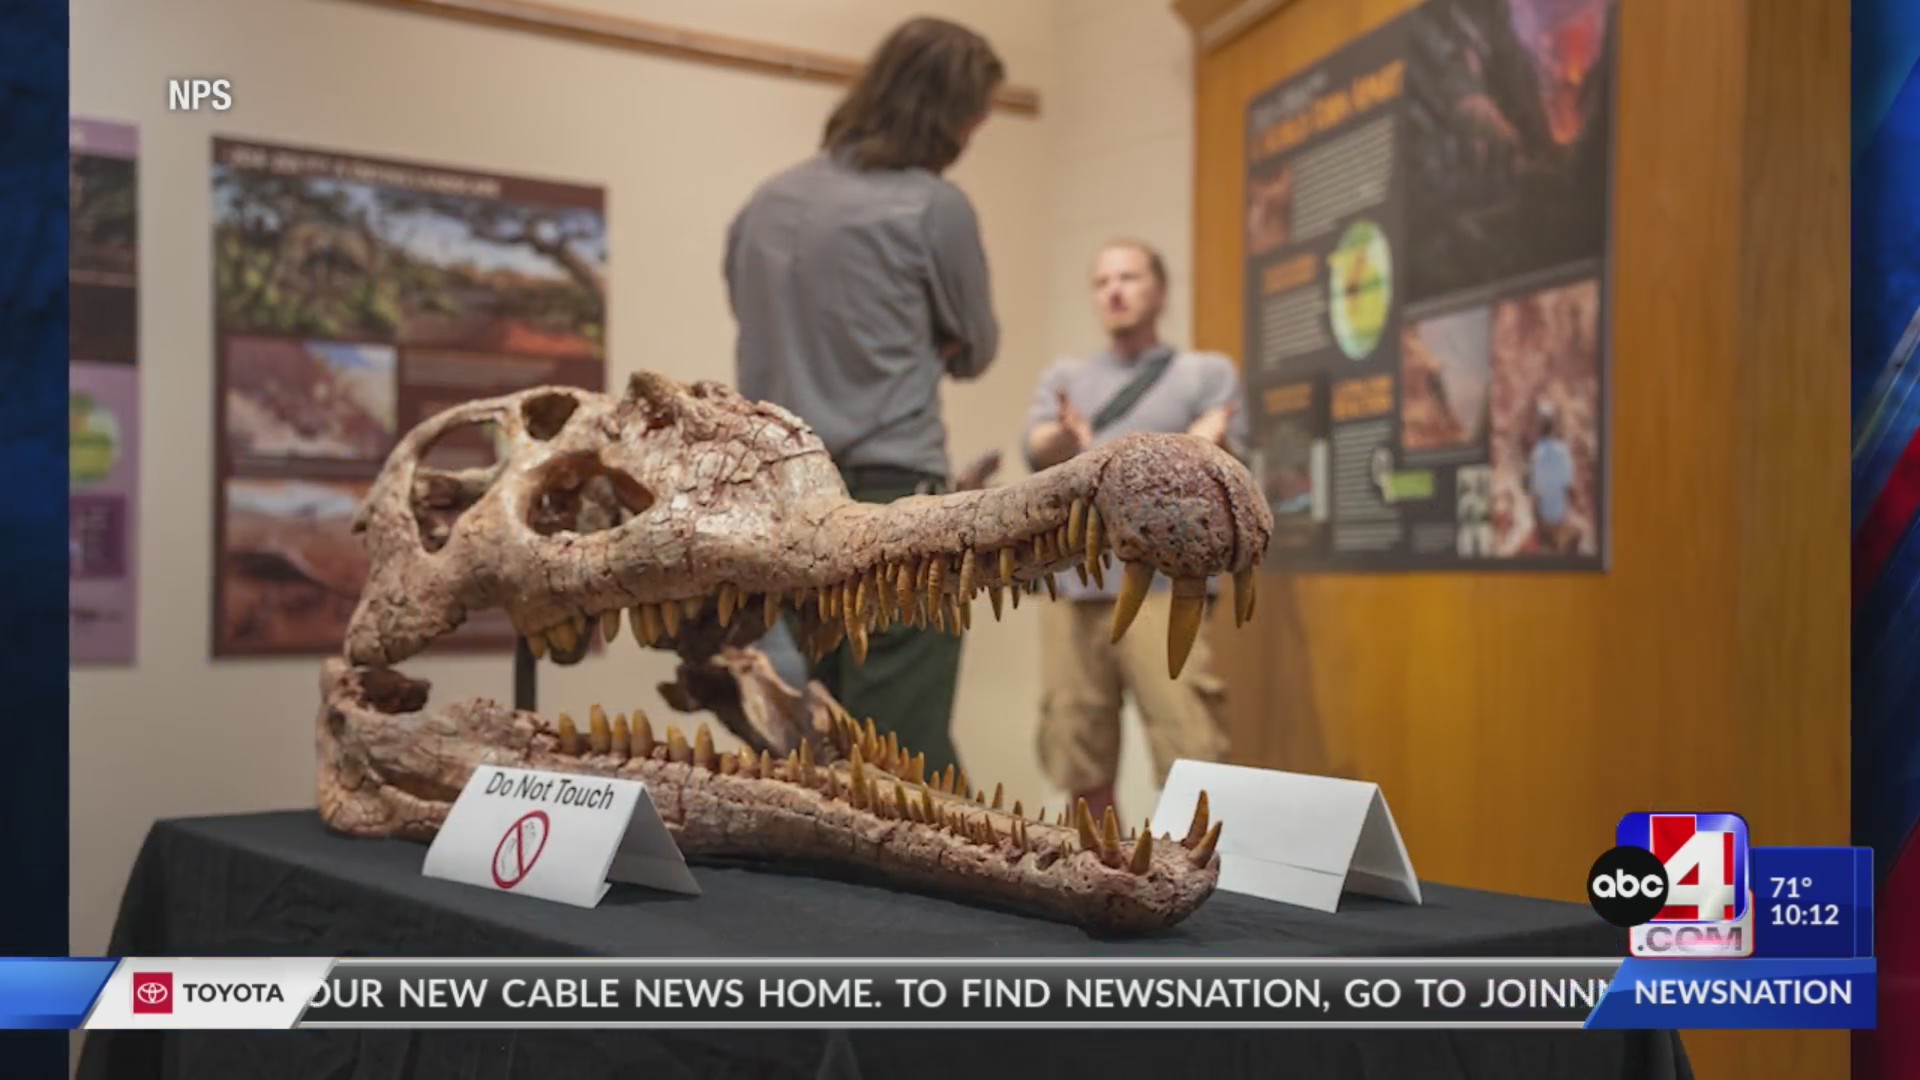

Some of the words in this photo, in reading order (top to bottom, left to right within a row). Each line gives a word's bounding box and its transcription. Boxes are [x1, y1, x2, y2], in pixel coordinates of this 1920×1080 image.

[485, 771, 511, 796] Do
[515, 775, 553, 801] Not
[554, 779, 614, 810] Touch
